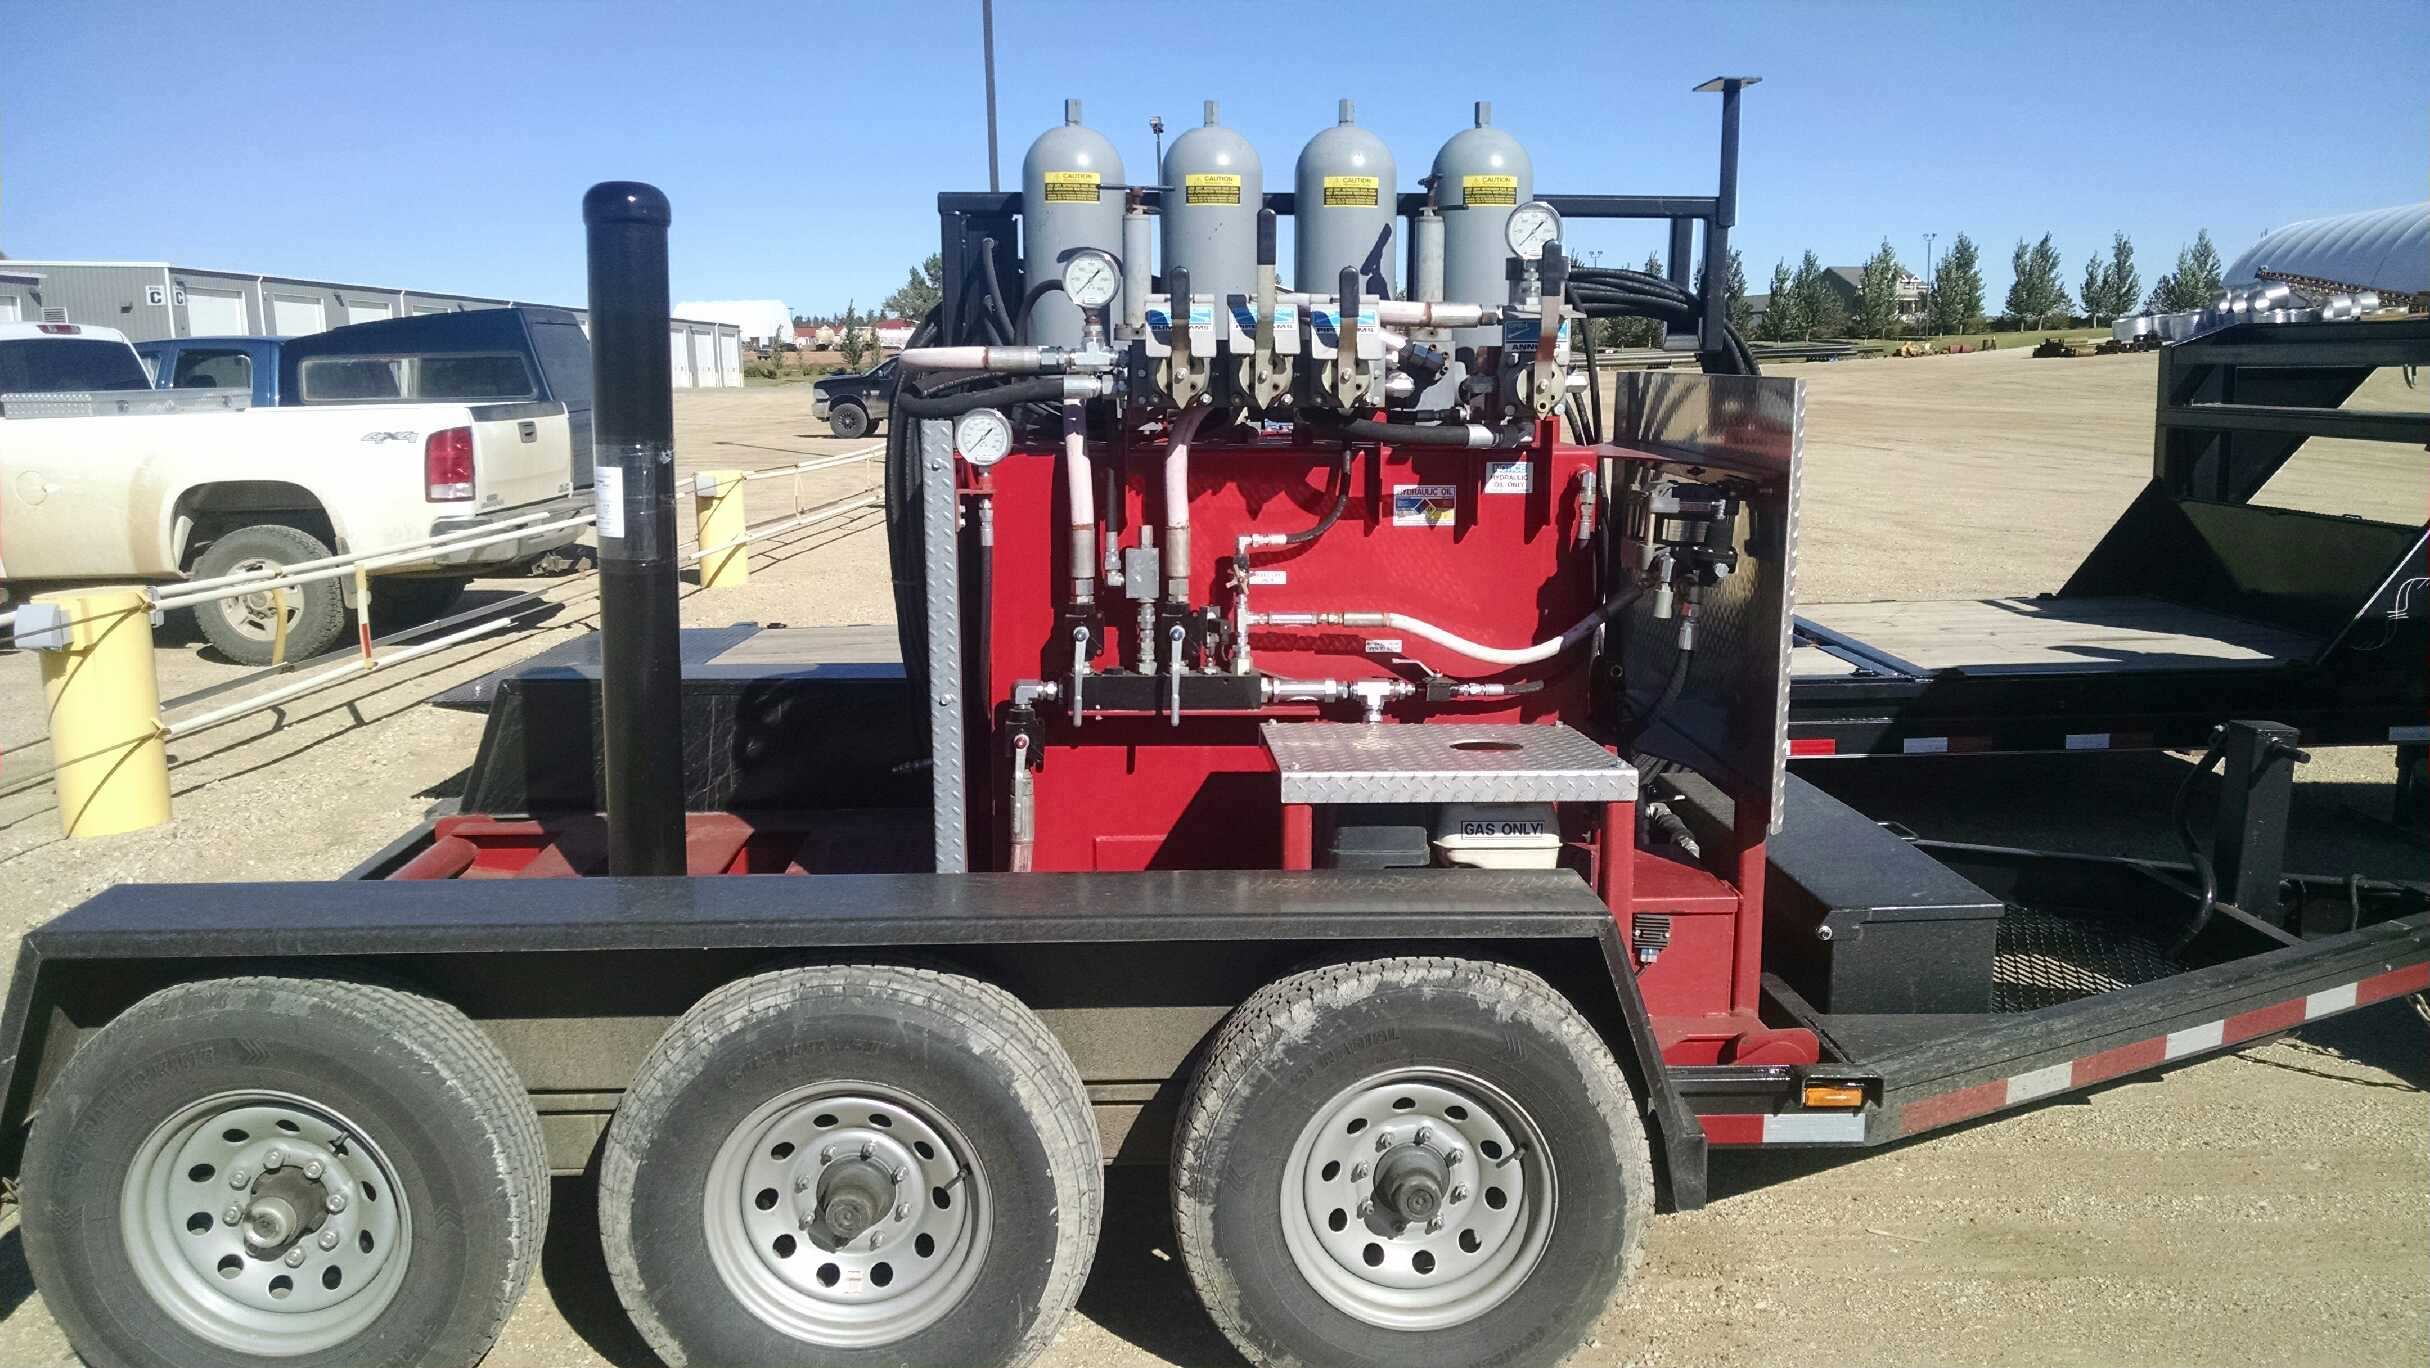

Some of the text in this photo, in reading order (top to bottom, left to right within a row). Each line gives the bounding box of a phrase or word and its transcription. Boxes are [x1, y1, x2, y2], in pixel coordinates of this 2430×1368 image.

[1203, 175, 1234, 183] CAUTION
[150, 291, 162, 304] C
[175, 291, 184, 305] C
[1494, 464, 1528, 473] NOTICE
[1398, 487, 1453, 496] YDRAULIC OIL
[1464, 822, 1544, 836] GAS ONLY!
